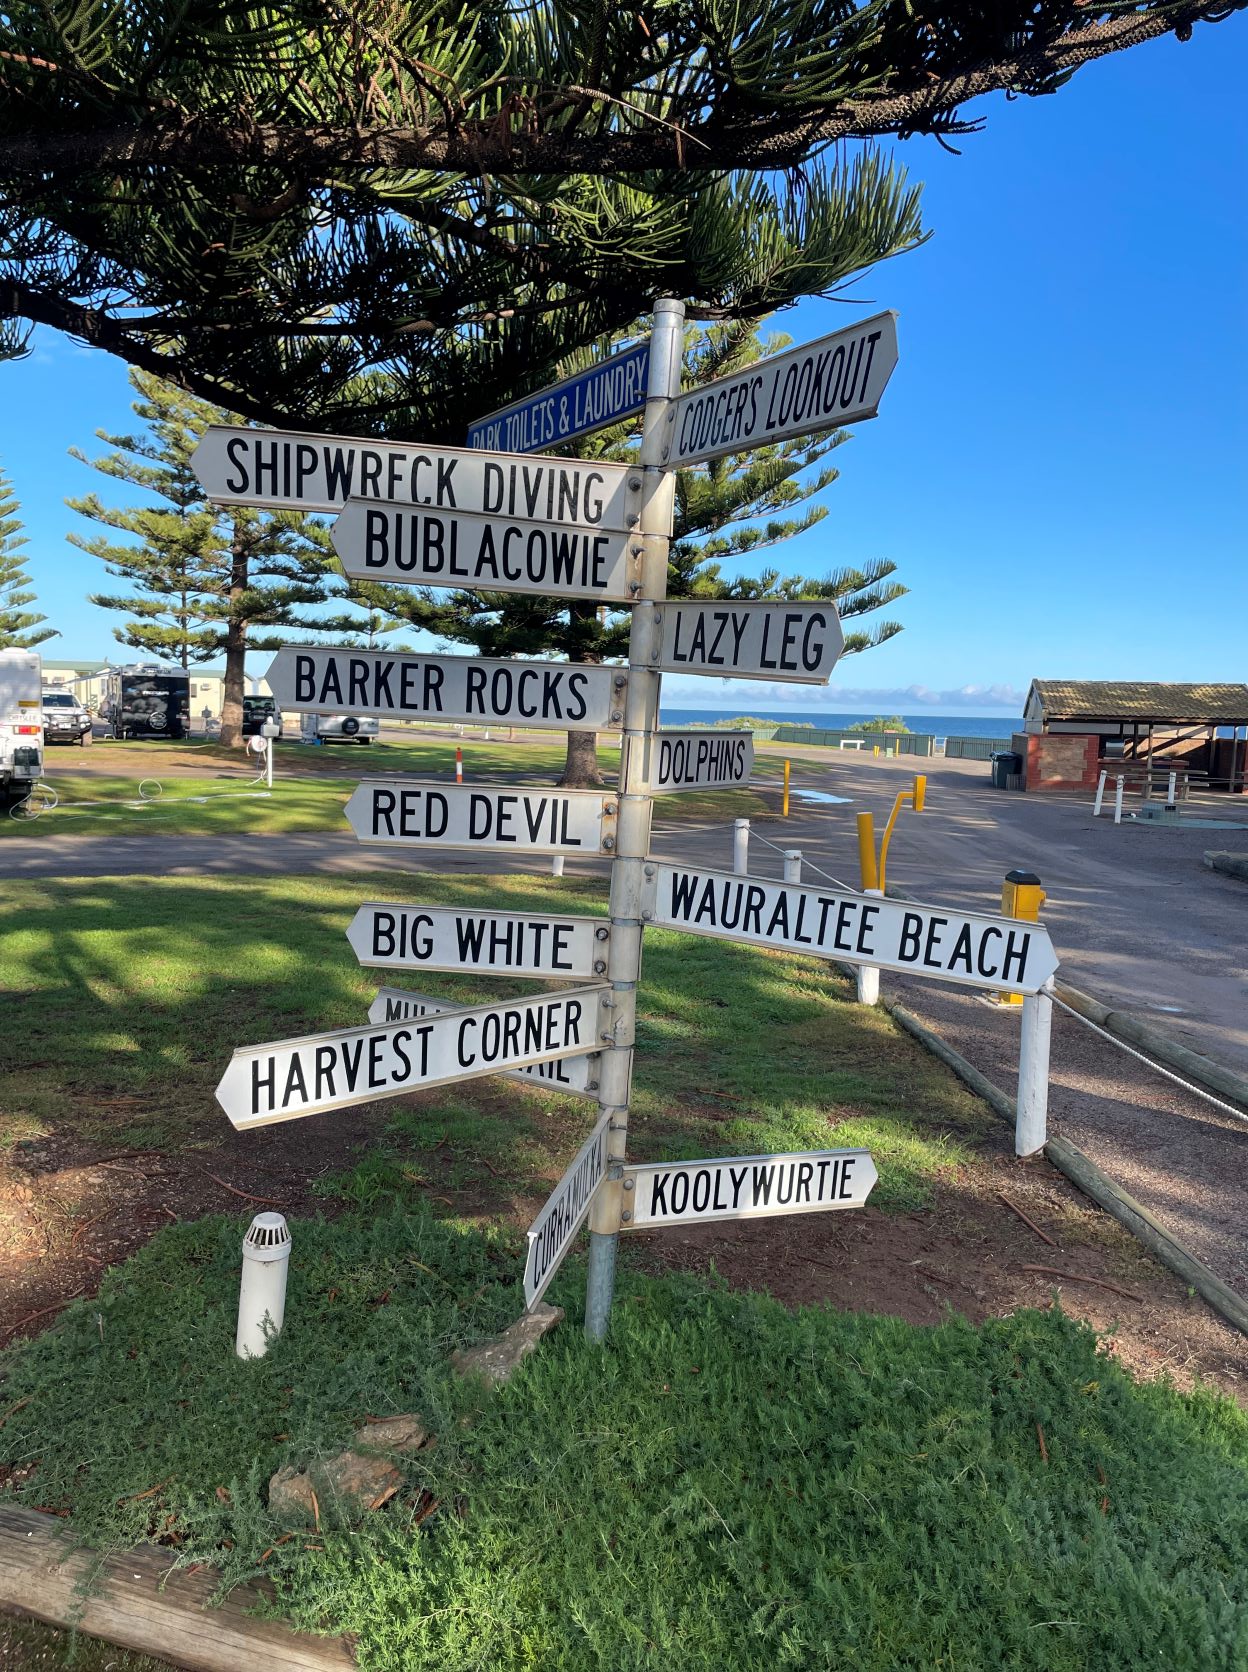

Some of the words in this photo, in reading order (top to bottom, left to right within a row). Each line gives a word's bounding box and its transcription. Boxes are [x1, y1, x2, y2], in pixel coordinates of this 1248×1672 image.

[506, 398, 555, 453] TOILETS
[558, 395, 570, 434] &
[574, 352, 648, 429] LAUNDRY
[679, 375, 763, 456] CODGER'S
[765, 331, 882, 430] LOOKOUT
[226, 437, 459, 509] SHIPWRECK
[483, 462, 605, 525] DIVING
[366, 510, 610, 588] BUBLACOWIE
[673, 611, 750, 666] LAZY
[760, 612, 827, 671] LEG
[295, 655, 445, 712] BARKER
[466, 666, 588, 721] ROCKS
[658, 739, 746, 785] DOLPHINS
[372, 789, 449, 838] RED
[469, 794, 581, 846] DEVIL
[372, 911, 434, 960] BIG
[455, 917, 575, 970] WHITE
[671, 872, 880, 955] WAURALTEE
[898, 912, 1031, 984] BEACH
[251, 1025, 434, 1114] HARVEST
[457, 1000, 582, 1068] CORNER
[650, 1159, 856, 1217] KOOLYWURTIE
